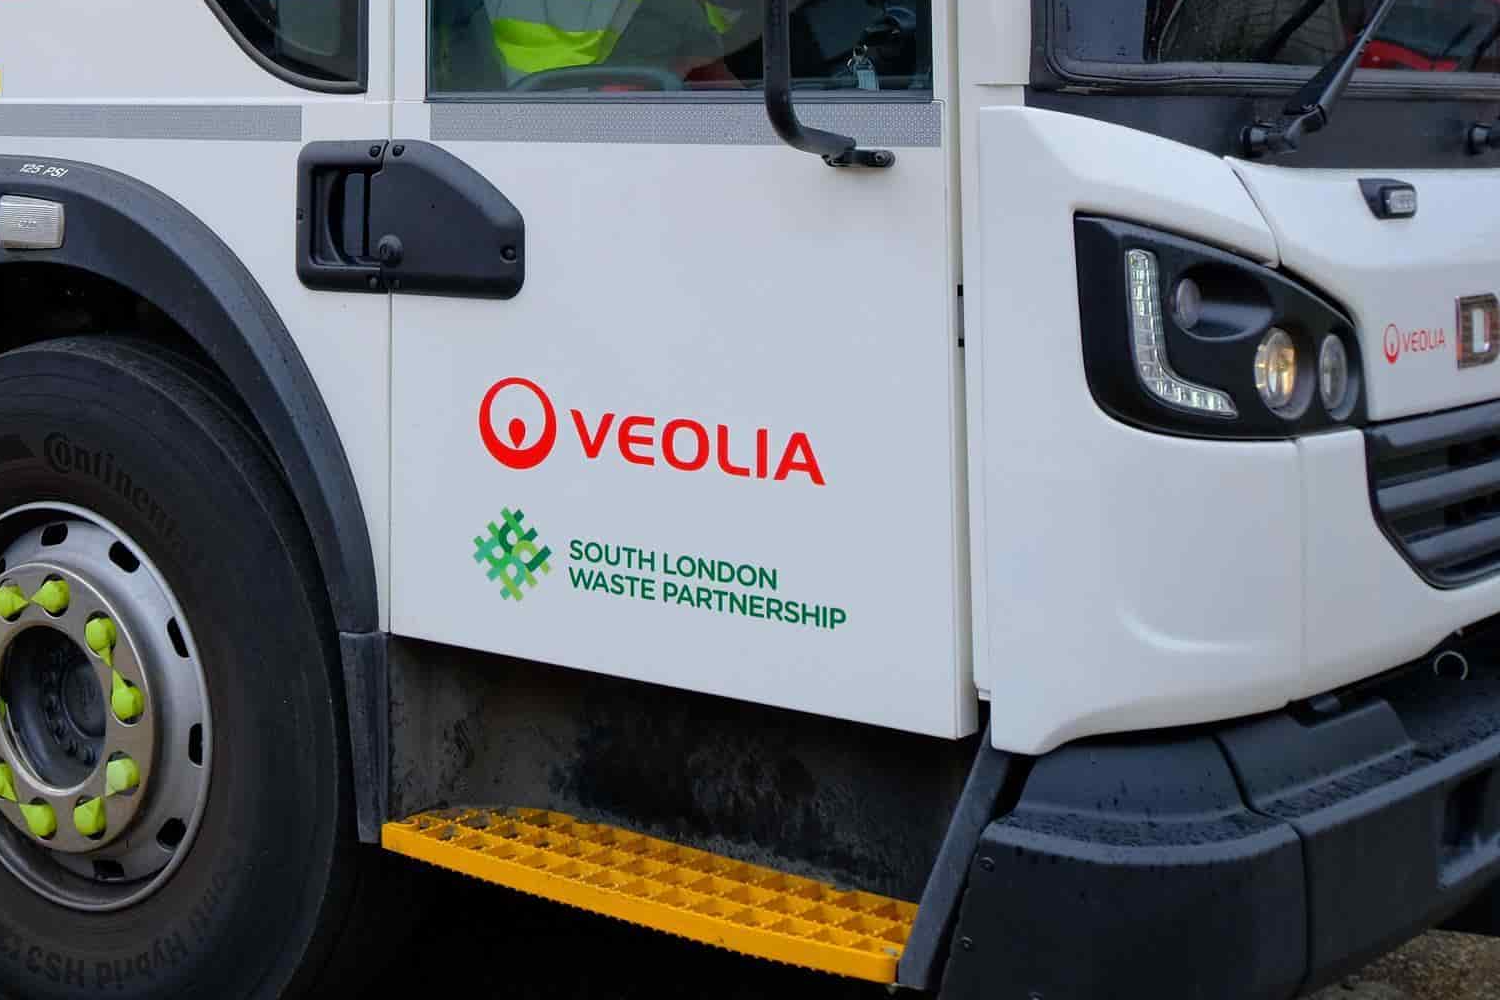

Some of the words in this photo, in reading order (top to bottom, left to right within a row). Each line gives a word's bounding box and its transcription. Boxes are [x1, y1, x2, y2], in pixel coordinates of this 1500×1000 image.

[43, 166, 68, 178] PSI
[1402, 328, 1445, 353] VEOLIA
[569, 408, 826, 486] VEOLIA
[569, 539, 655, 572] SOUTH
[663, 553, 777, 590] LONDON
[568, 566, 655, 600] WASTE
[663, 582, 846, 629] PARTNERSHIP
